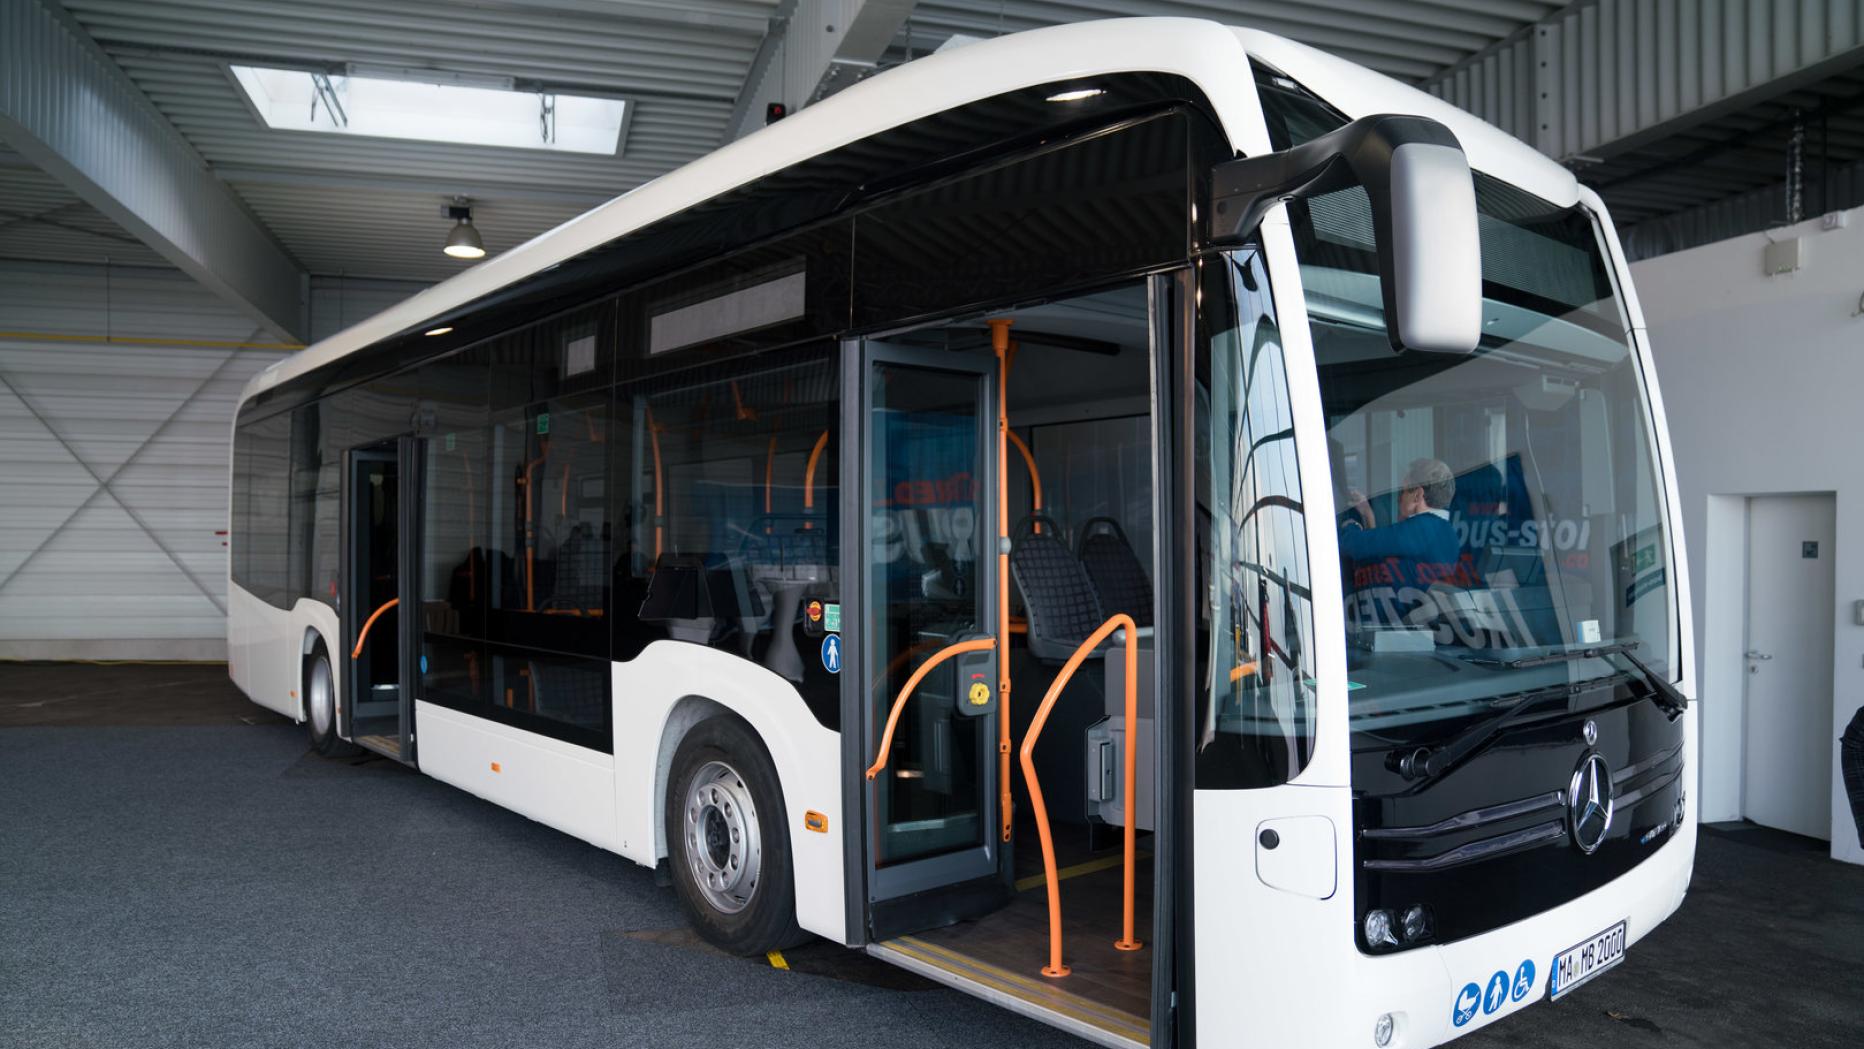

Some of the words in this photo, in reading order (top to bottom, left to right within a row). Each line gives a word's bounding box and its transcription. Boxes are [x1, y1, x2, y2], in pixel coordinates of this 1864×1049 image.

[1559, 955, 1573, 987] MA
[1581, 943, 1594, 975] MB
[1597, 928, 1622, 965] 2000
